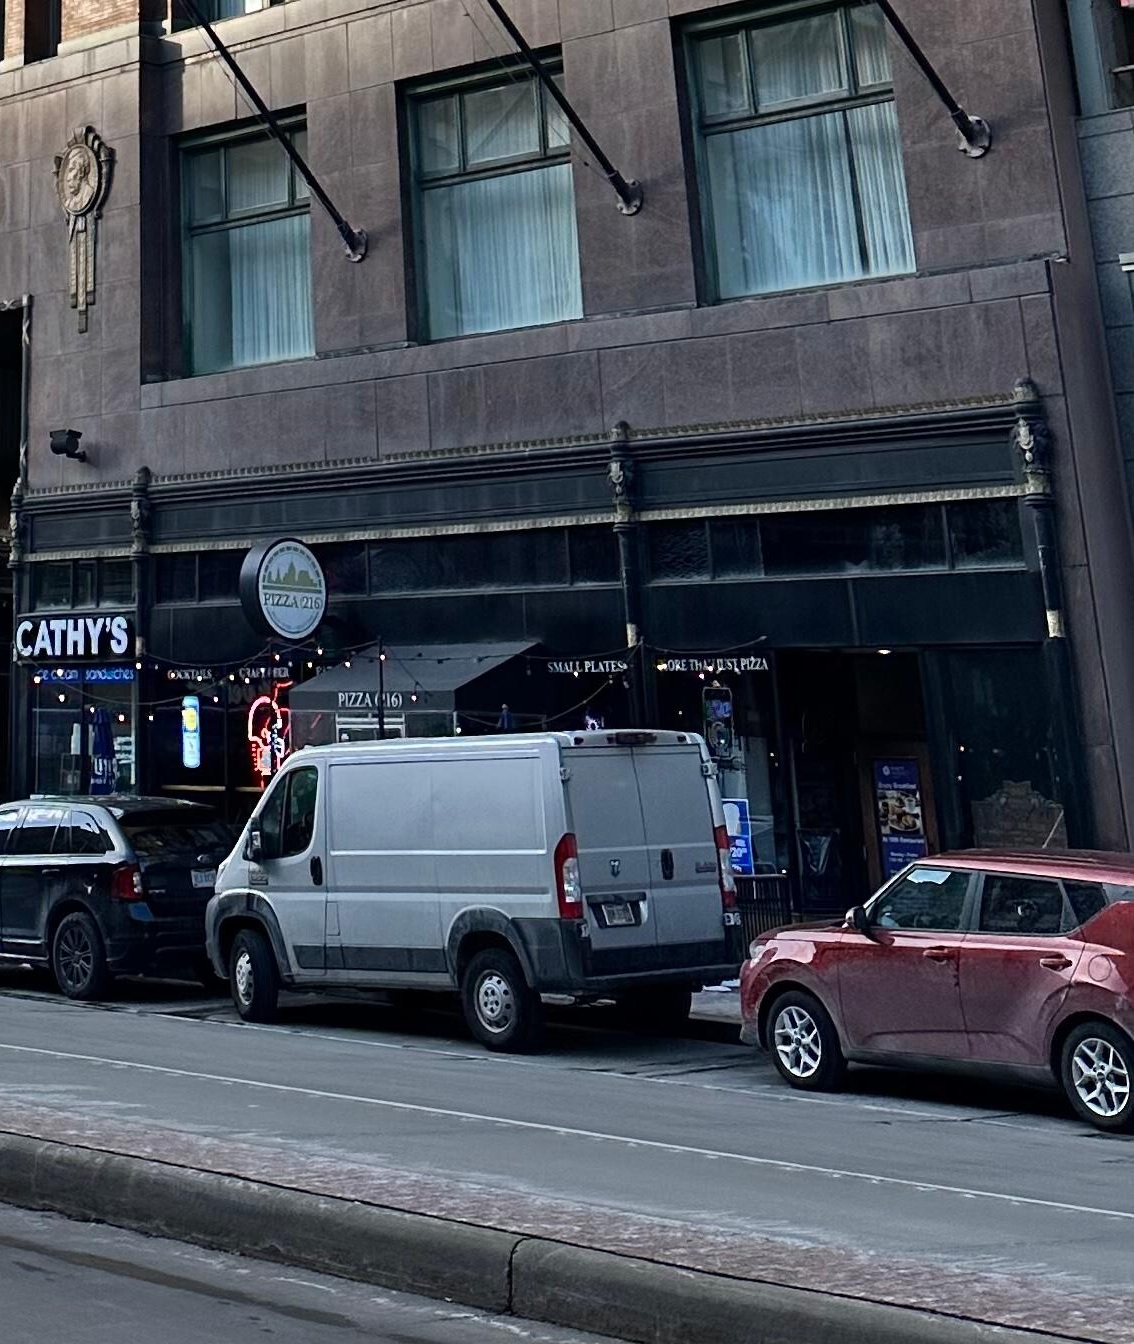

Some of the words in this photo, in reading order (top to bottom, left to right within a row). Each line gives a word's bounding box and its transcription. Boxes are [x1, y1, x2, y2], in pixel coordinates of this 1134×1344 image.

[263, 592, 299, 608] PIZZA
[16, 616, 128, 657] CATHY'S
[547, 660, 584, 673] SMALL
[584, 660, 627, 673] PLATES
[657, 658, 687, 671] ORE
[740, 657, 769, 671] PIZZA
[338, 692, 372, 708] PIZZA
[374, 692, 403, 708] (16)
